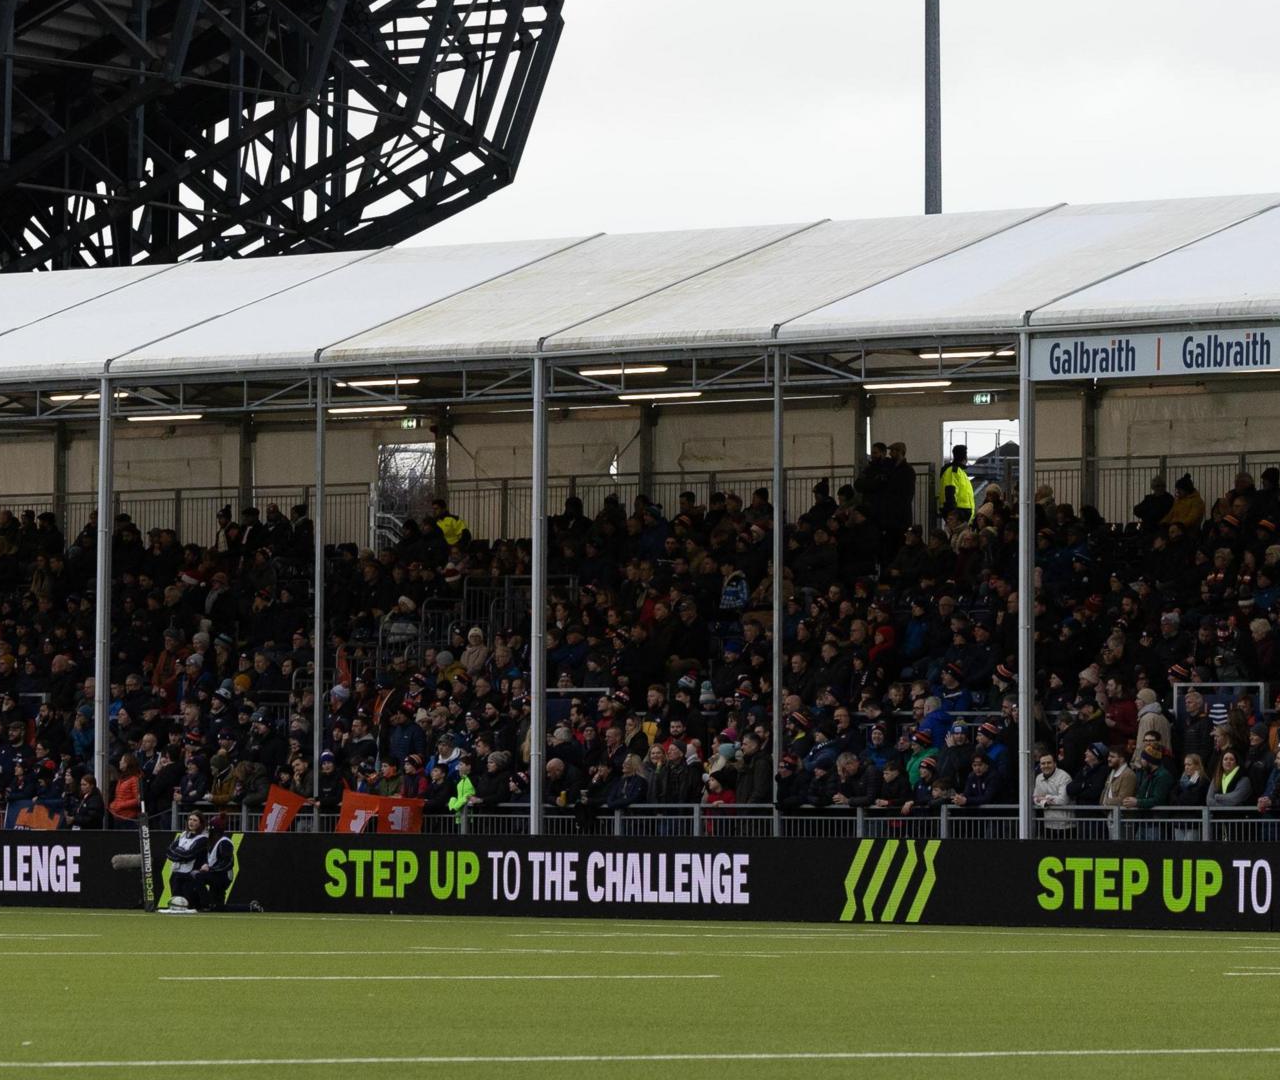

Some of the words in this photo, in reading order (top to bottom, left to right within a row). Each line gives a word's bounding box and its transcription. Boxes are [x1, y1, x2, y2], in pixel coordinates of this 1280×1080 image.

[1049, 338, 1136, 375] Galbraith
[1182, 332, 1271, 369] Galbraith
[143, 839, 152, 873] CHALLENGE
[145, 877, 154, 901] EPCR
[325, 849, 419, 898] STEP
[430, 851, 480, 900] UP
[488, 851, 520, 901] TO
[528, 852, 579, 902] THE
[587, 852, 750, 905] CHALLENGE
[1038, 857, 1149, 911] STEP
[1163, 859, 1222, 913] UP
[1233, 860, 1272, 914] TO
